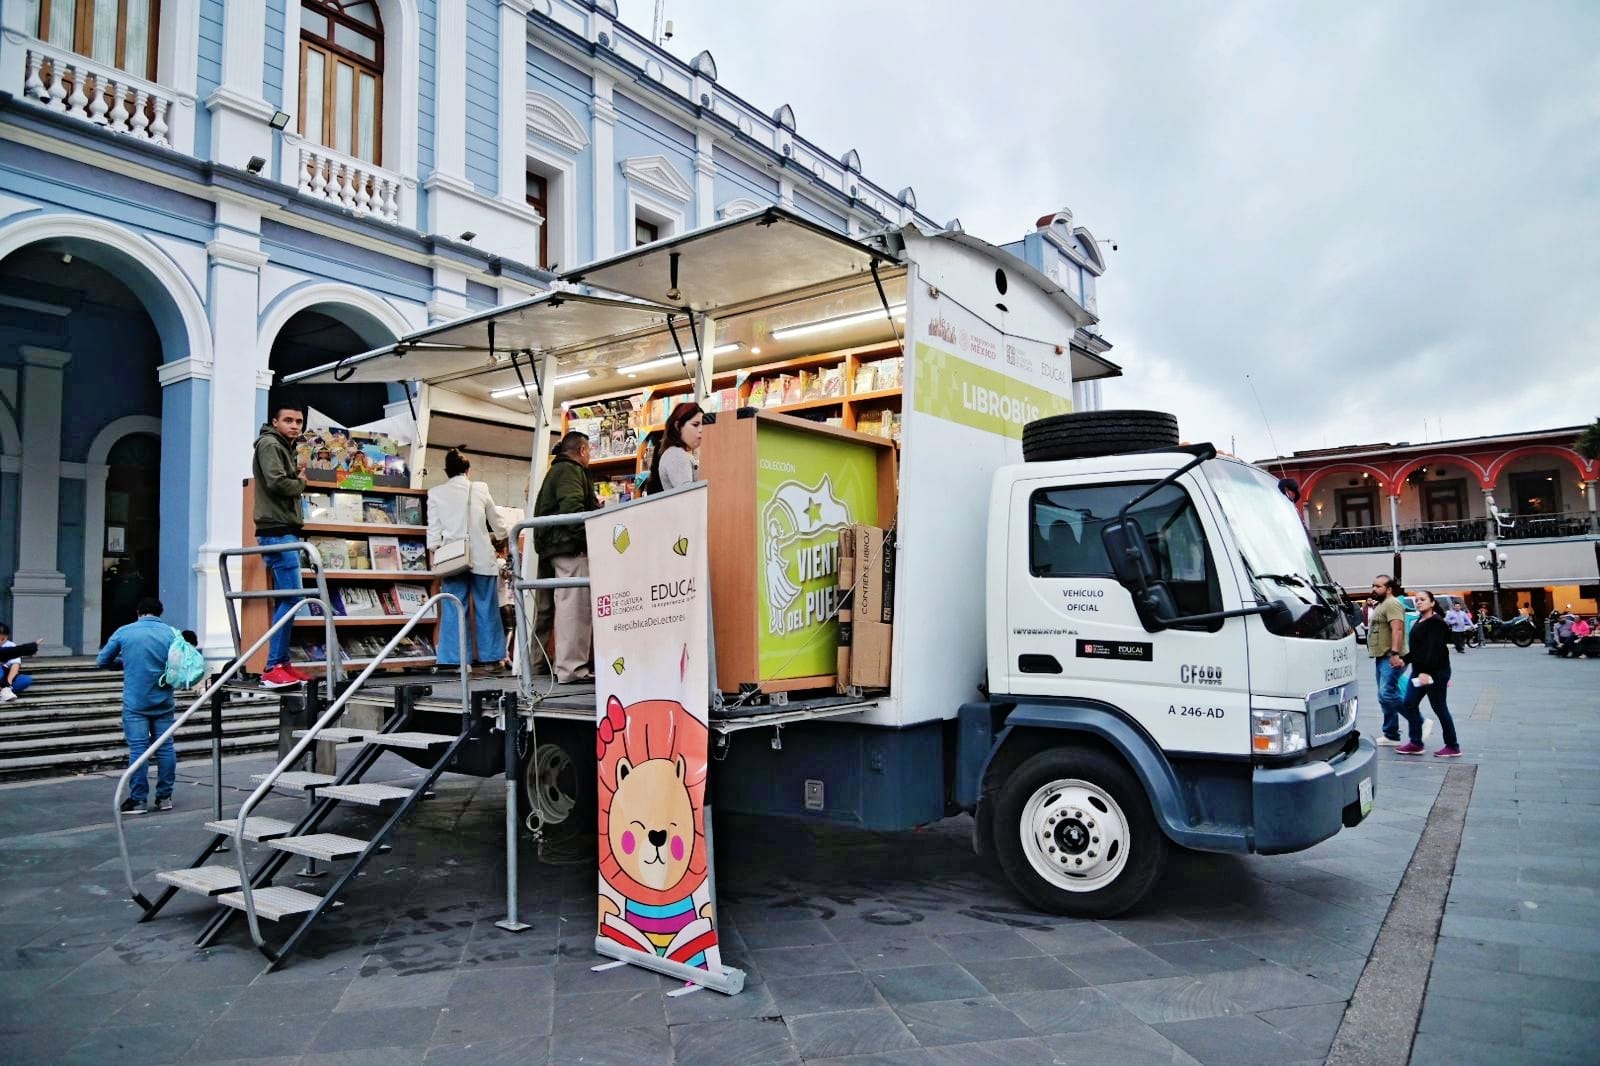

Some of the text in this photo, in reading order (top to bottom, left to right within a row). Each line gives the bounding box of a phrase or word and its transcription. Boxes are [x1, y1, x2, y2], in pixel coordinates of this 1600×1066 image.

[962, 381, 1040, 425] LIBROBÚS
[861, 529, 871, 616] CONTIENE LIBROS
[611, 590, 631, 600] FONDO
[1062, 588, 1104, 598] VEHÍCULO
[619, 596, 643, 607] CULTURA
[1066, 603, 1099, 612] OFICIAL
[787, 608, 804, 632] DEL
[1167, 704, 1225, 719] A 246-AD
